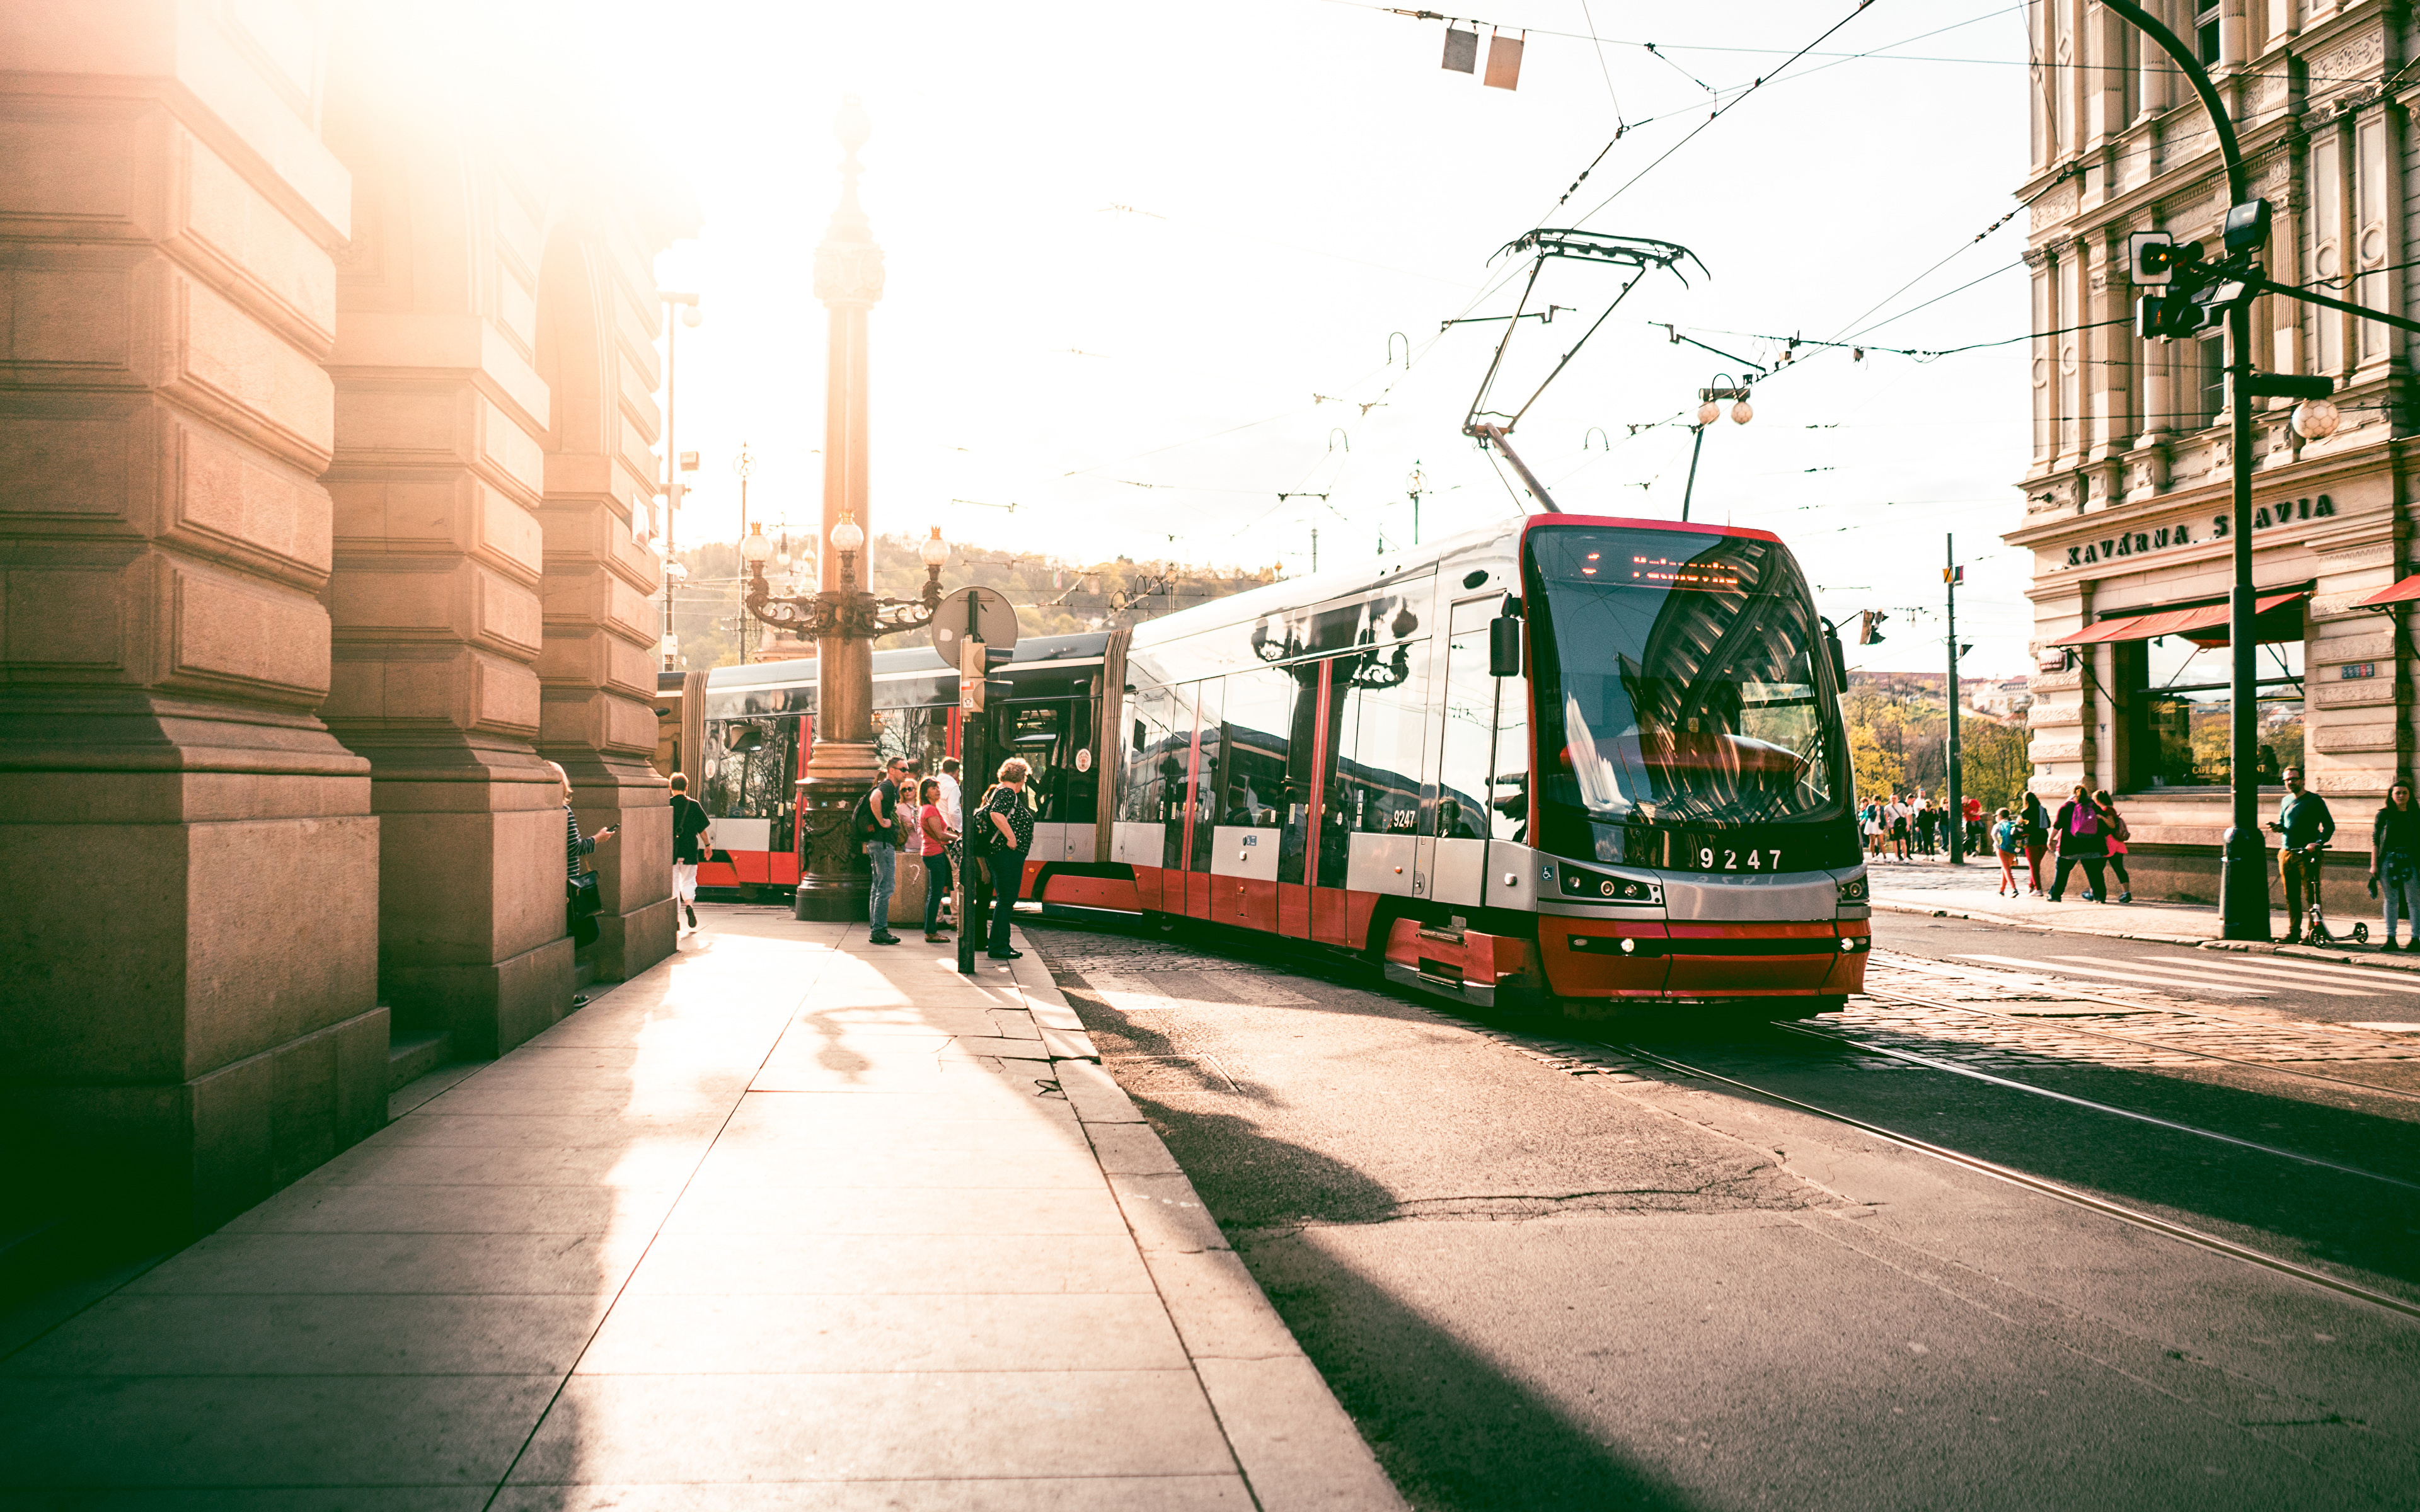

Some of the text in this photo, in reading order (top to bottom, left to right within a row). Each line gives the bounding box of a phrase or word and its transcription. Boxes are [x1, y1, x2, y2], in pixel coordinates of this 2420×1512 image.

[2068, 494, 2336, 566] KAVÁRNA SAVIA
[1393, 810, 1416, 828] 9247
[1700, 847, 1782, 869] 9247
